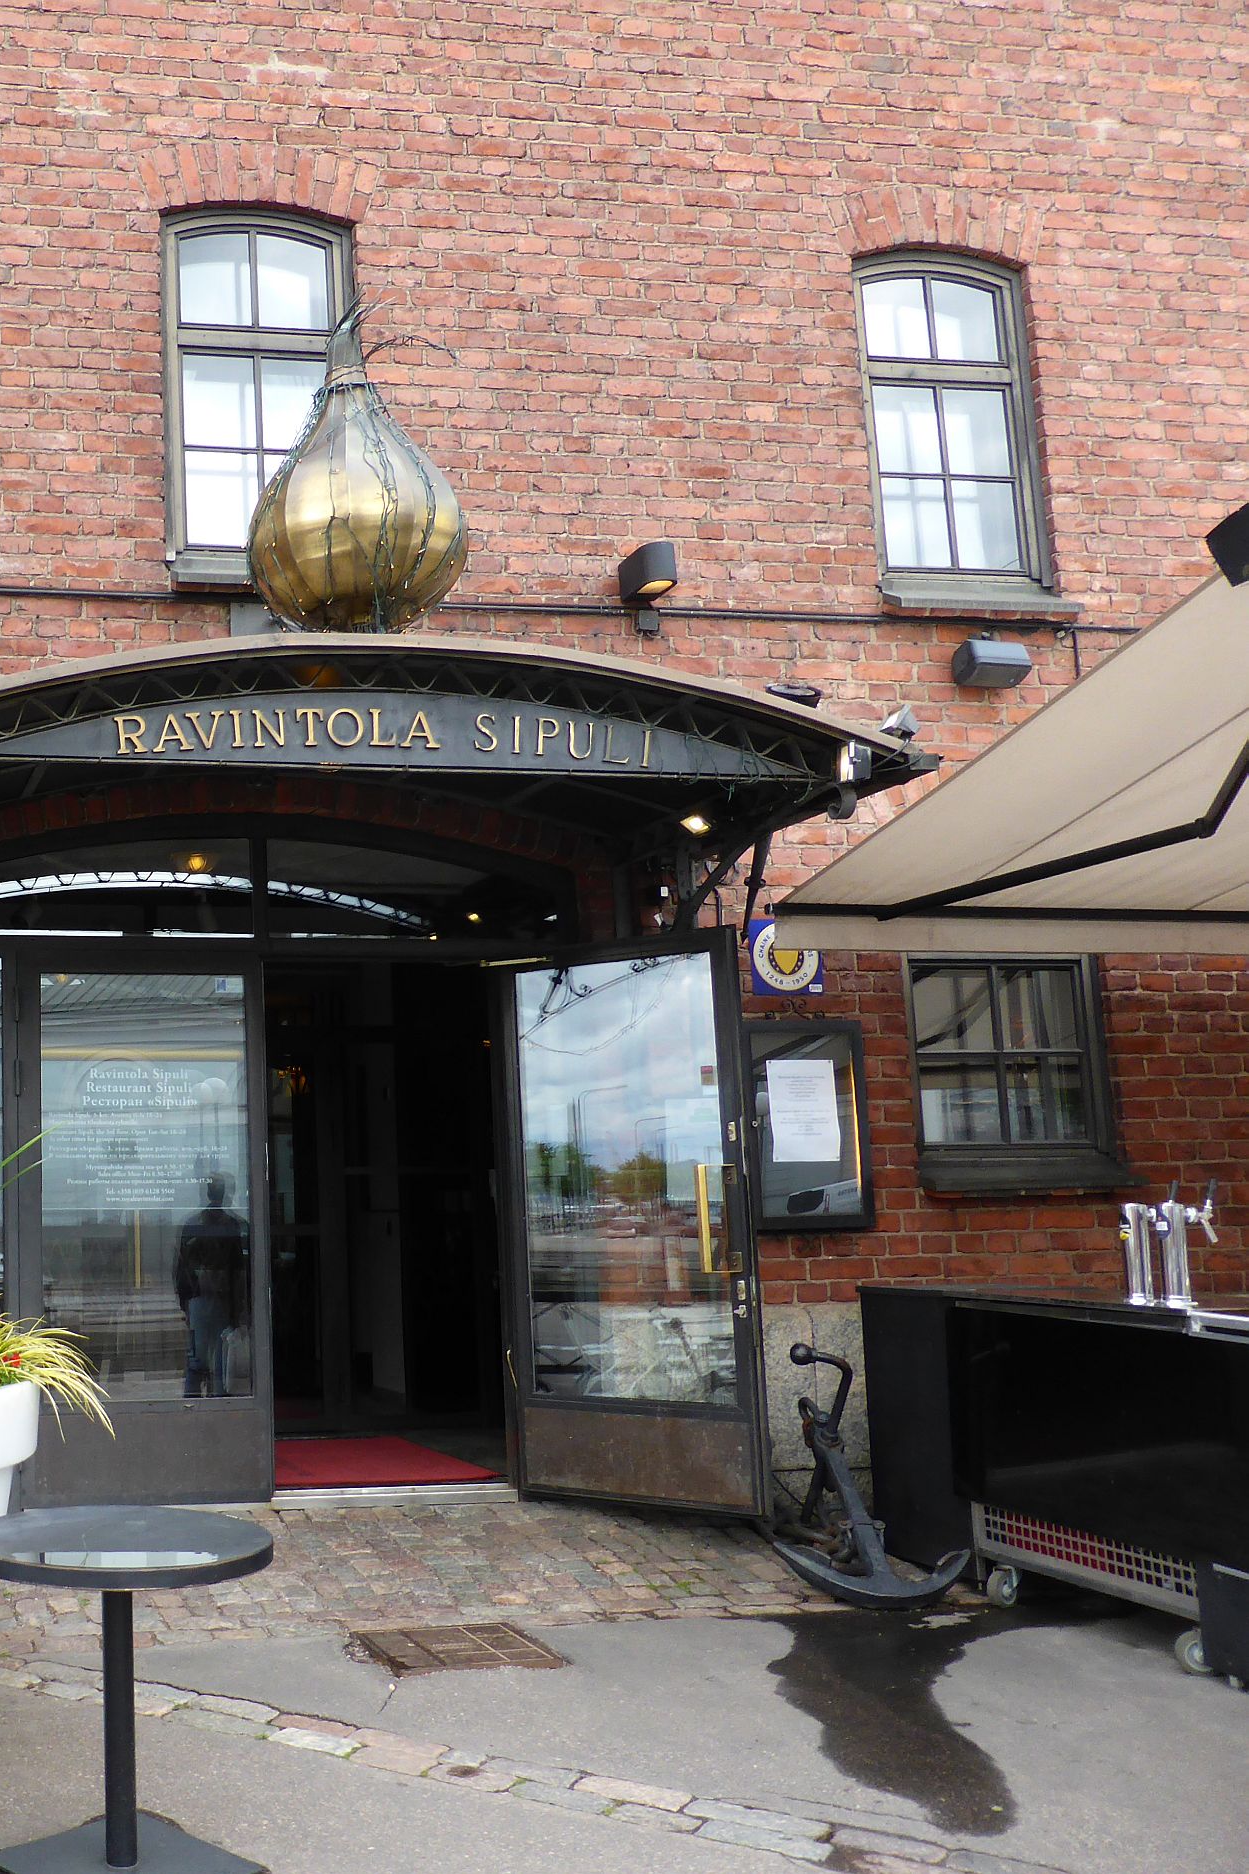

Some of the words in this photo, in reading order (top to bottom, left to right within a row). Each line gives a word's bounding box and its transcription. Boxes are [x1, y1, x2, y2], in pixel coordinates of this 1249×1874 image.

[113, 708, 441, 755] RAVINTOLA
[473, 713, 652, 768] SIPULI
[90, 1067, 149, 1080] Ravintola
[152, 1067, 189, 1083] Sipuli
[86, 1081, 152, 1094] Restaurant
[156, 1081, 193, 1097] Sipuli
[82, 1095, 144, 1109] Ресторан
